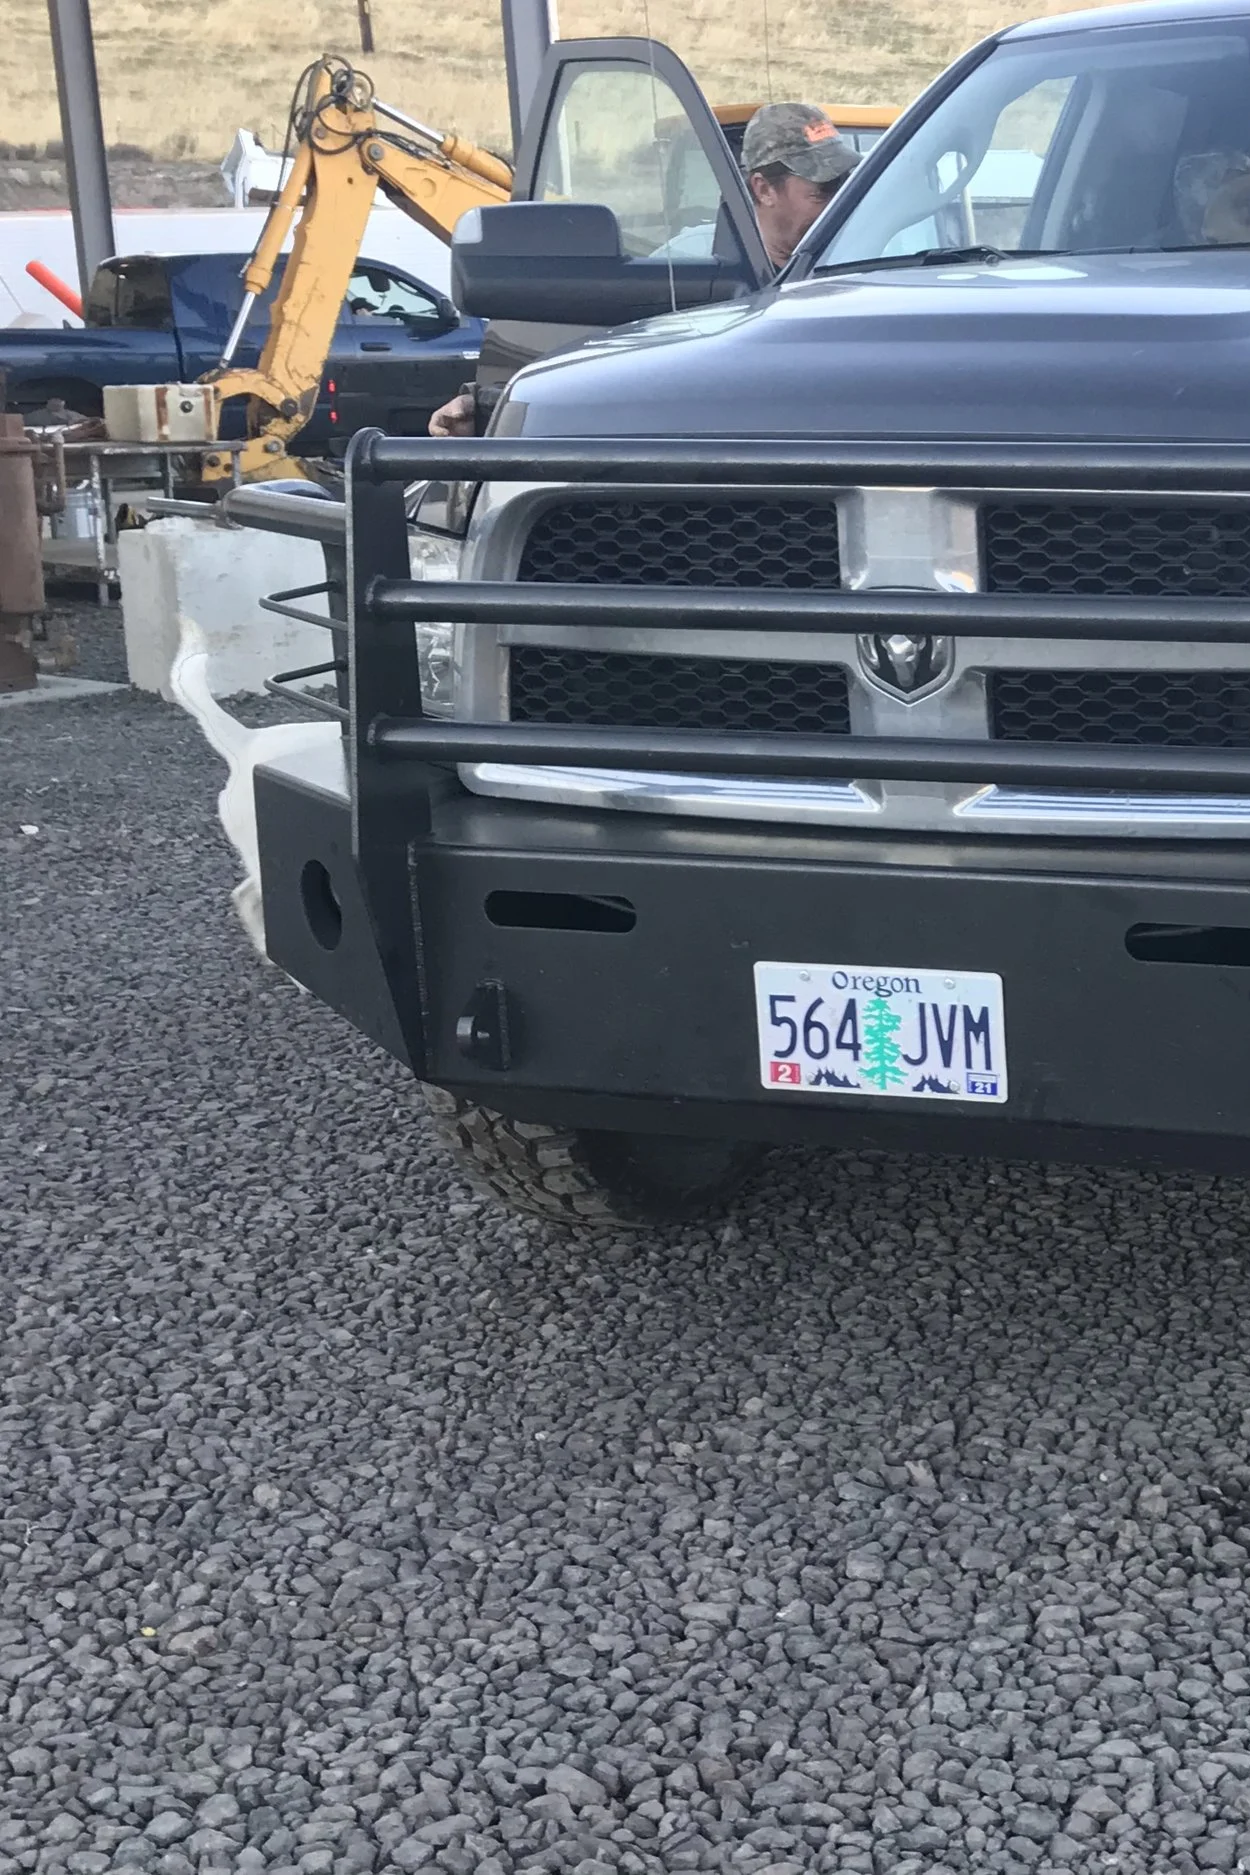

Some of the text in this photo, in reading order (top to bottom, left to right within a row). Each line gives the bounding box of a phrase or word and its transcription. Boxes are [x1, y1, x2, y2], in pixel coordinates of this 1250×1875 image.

[832, 970, 922, 998] Oregon
[769, 994, 992, 1071] 564 JVM
[777, 1064, 793, 1082] 2
[974, 1081, 992, 1094] 21
